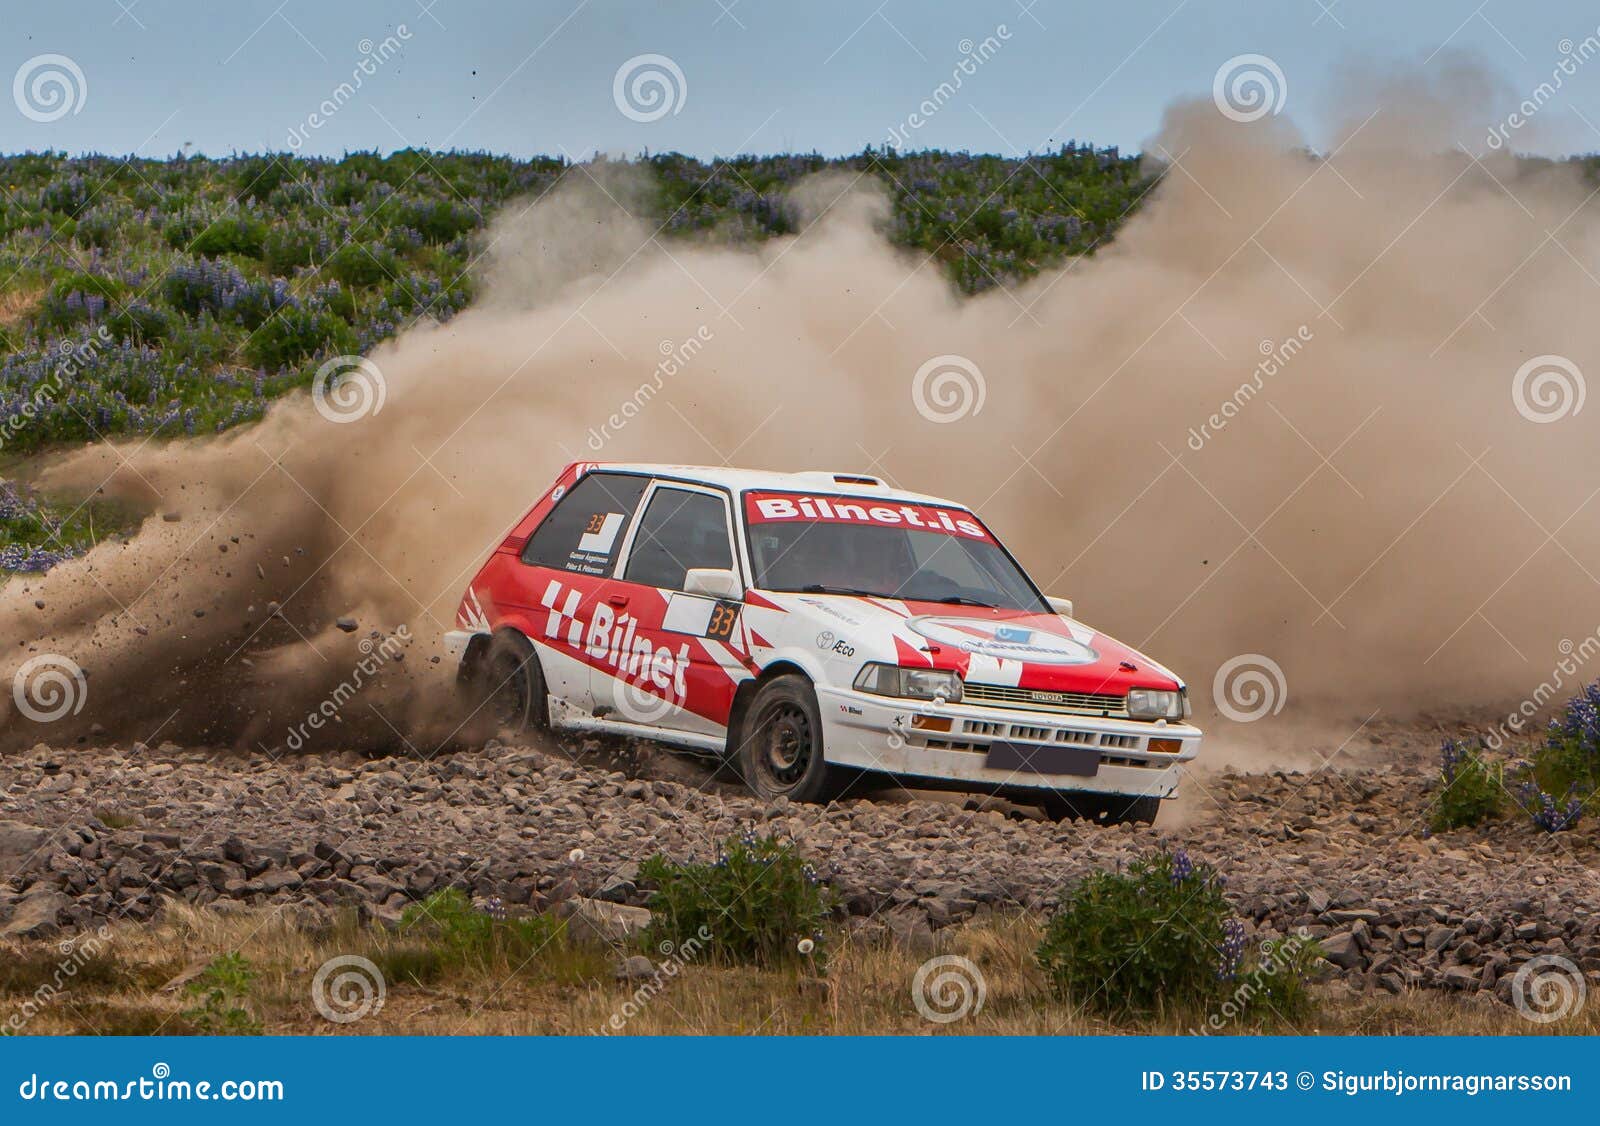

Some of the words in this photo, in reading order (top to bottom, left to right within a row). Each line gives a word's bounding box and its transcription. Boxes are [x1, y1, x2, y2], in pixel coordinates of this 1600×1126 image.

[586, 513, 606, 532] 33
[755, 496, 985, 538] Bílnet.is
[708, 605, 735, 637] 33
[585, 601, 690, 698] Bílnet
[1033, 692, 1063, 702] TOYOTA
